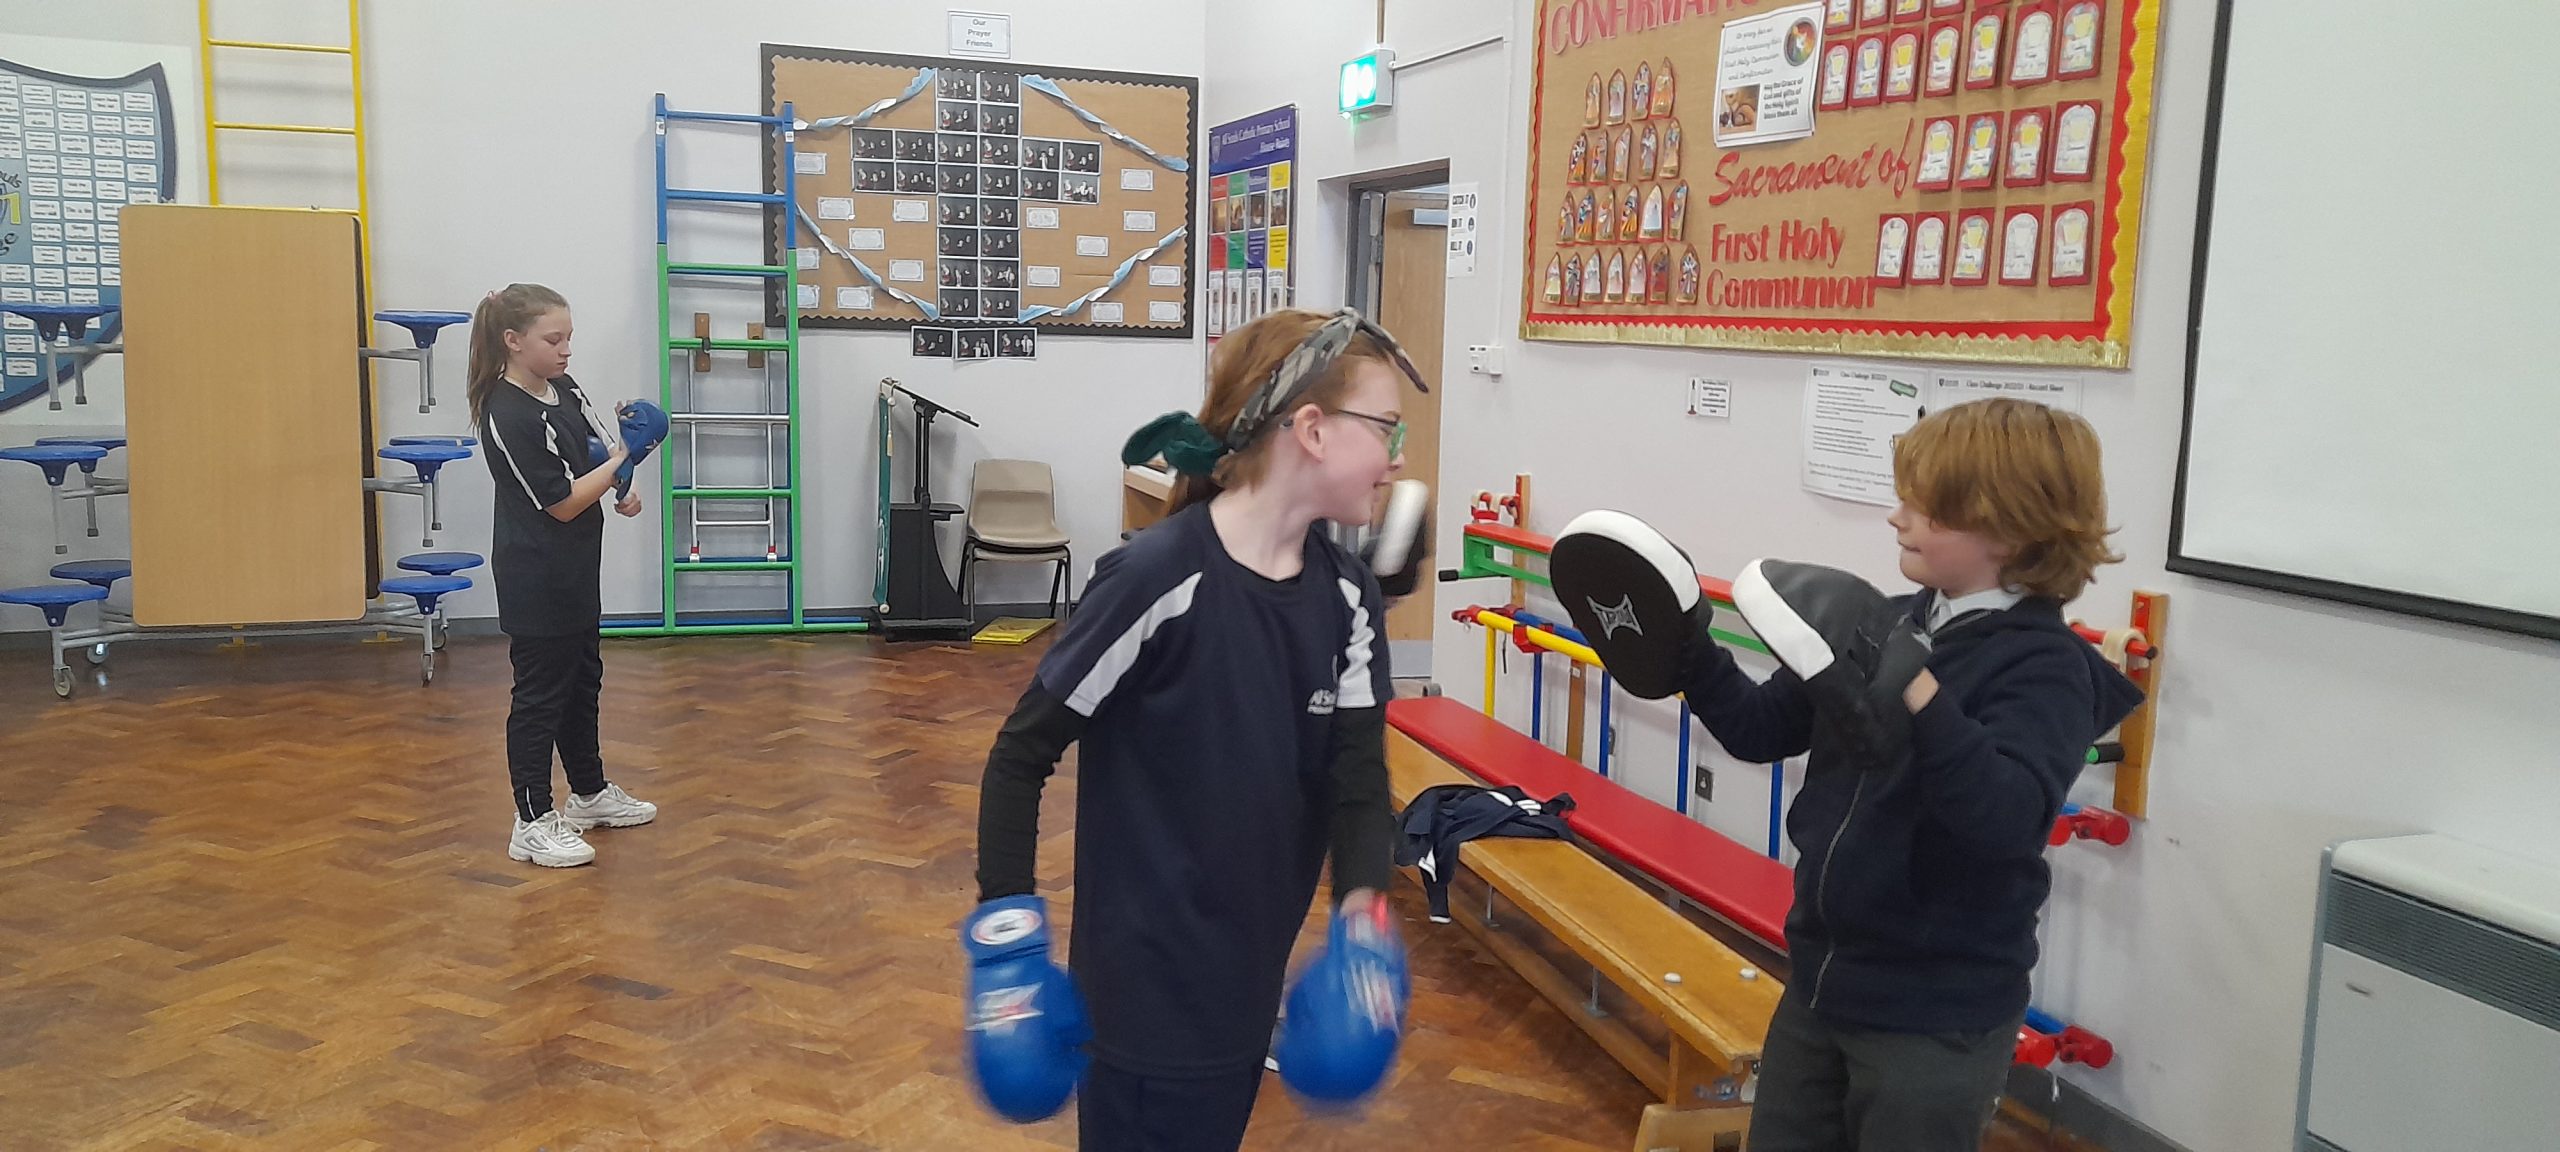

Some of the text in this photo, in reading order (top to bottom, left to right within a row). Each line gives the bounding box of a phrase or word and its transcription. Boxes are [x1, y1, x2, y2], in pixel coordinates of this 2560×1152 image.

[972, 18, 987, 26] Our
[967, 28, 992, 38] Prayer
[966, 39, 993, 48] Friends
[1274, 115, 1291, 132] School
[1708, 117, 1915, 206] Sacrament of
[1711, 216, 1847, 269] First Holy
[1706, 268, 1877, 309] Communion
